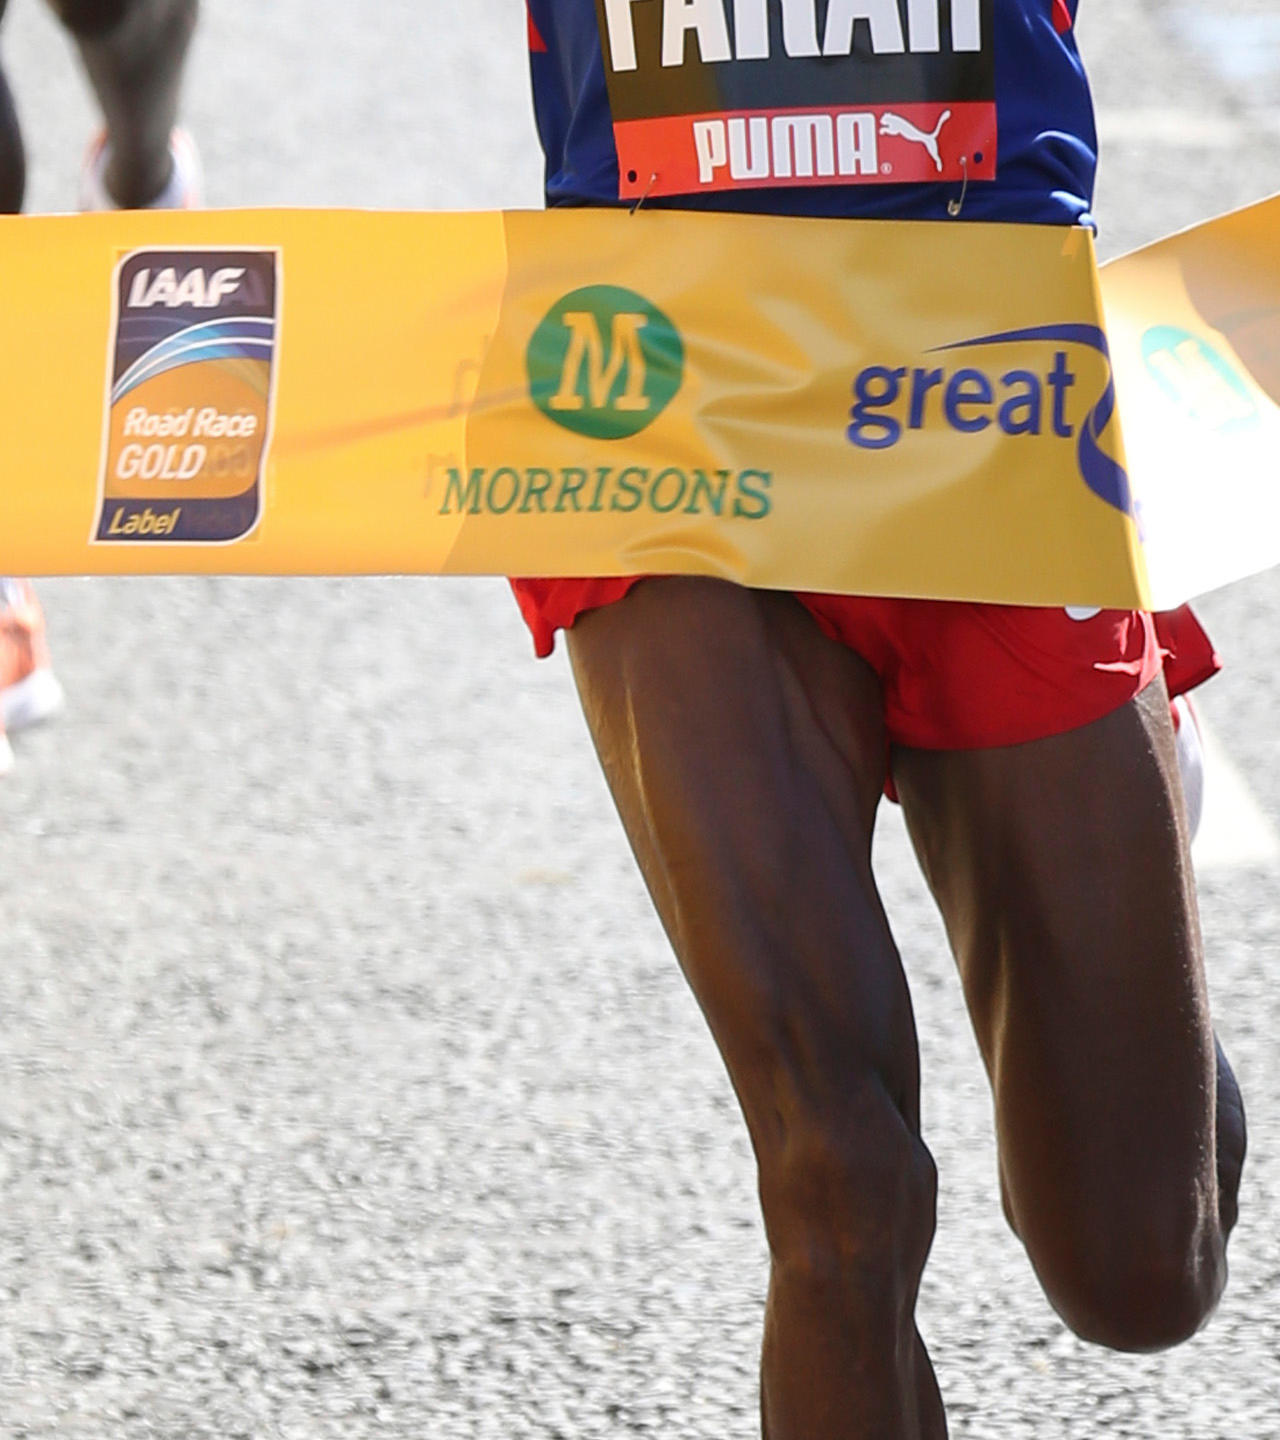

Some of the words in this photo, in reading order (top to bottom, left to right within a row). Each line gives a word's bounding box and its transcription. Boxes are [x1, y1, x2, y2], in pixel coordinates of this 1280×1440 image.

[693, 112, 880, 184] PUMA
[127, 267, 246, 308] IAAF
[846, 351, 1076, 449] great
[123, 406, 192, 438] Road
[192, 407, 257, 439] Race
[116, 444, 206, 480] GOLD
[438, 466, 773, 520] MORRISONS
[108, 506, 181, 535] Label
